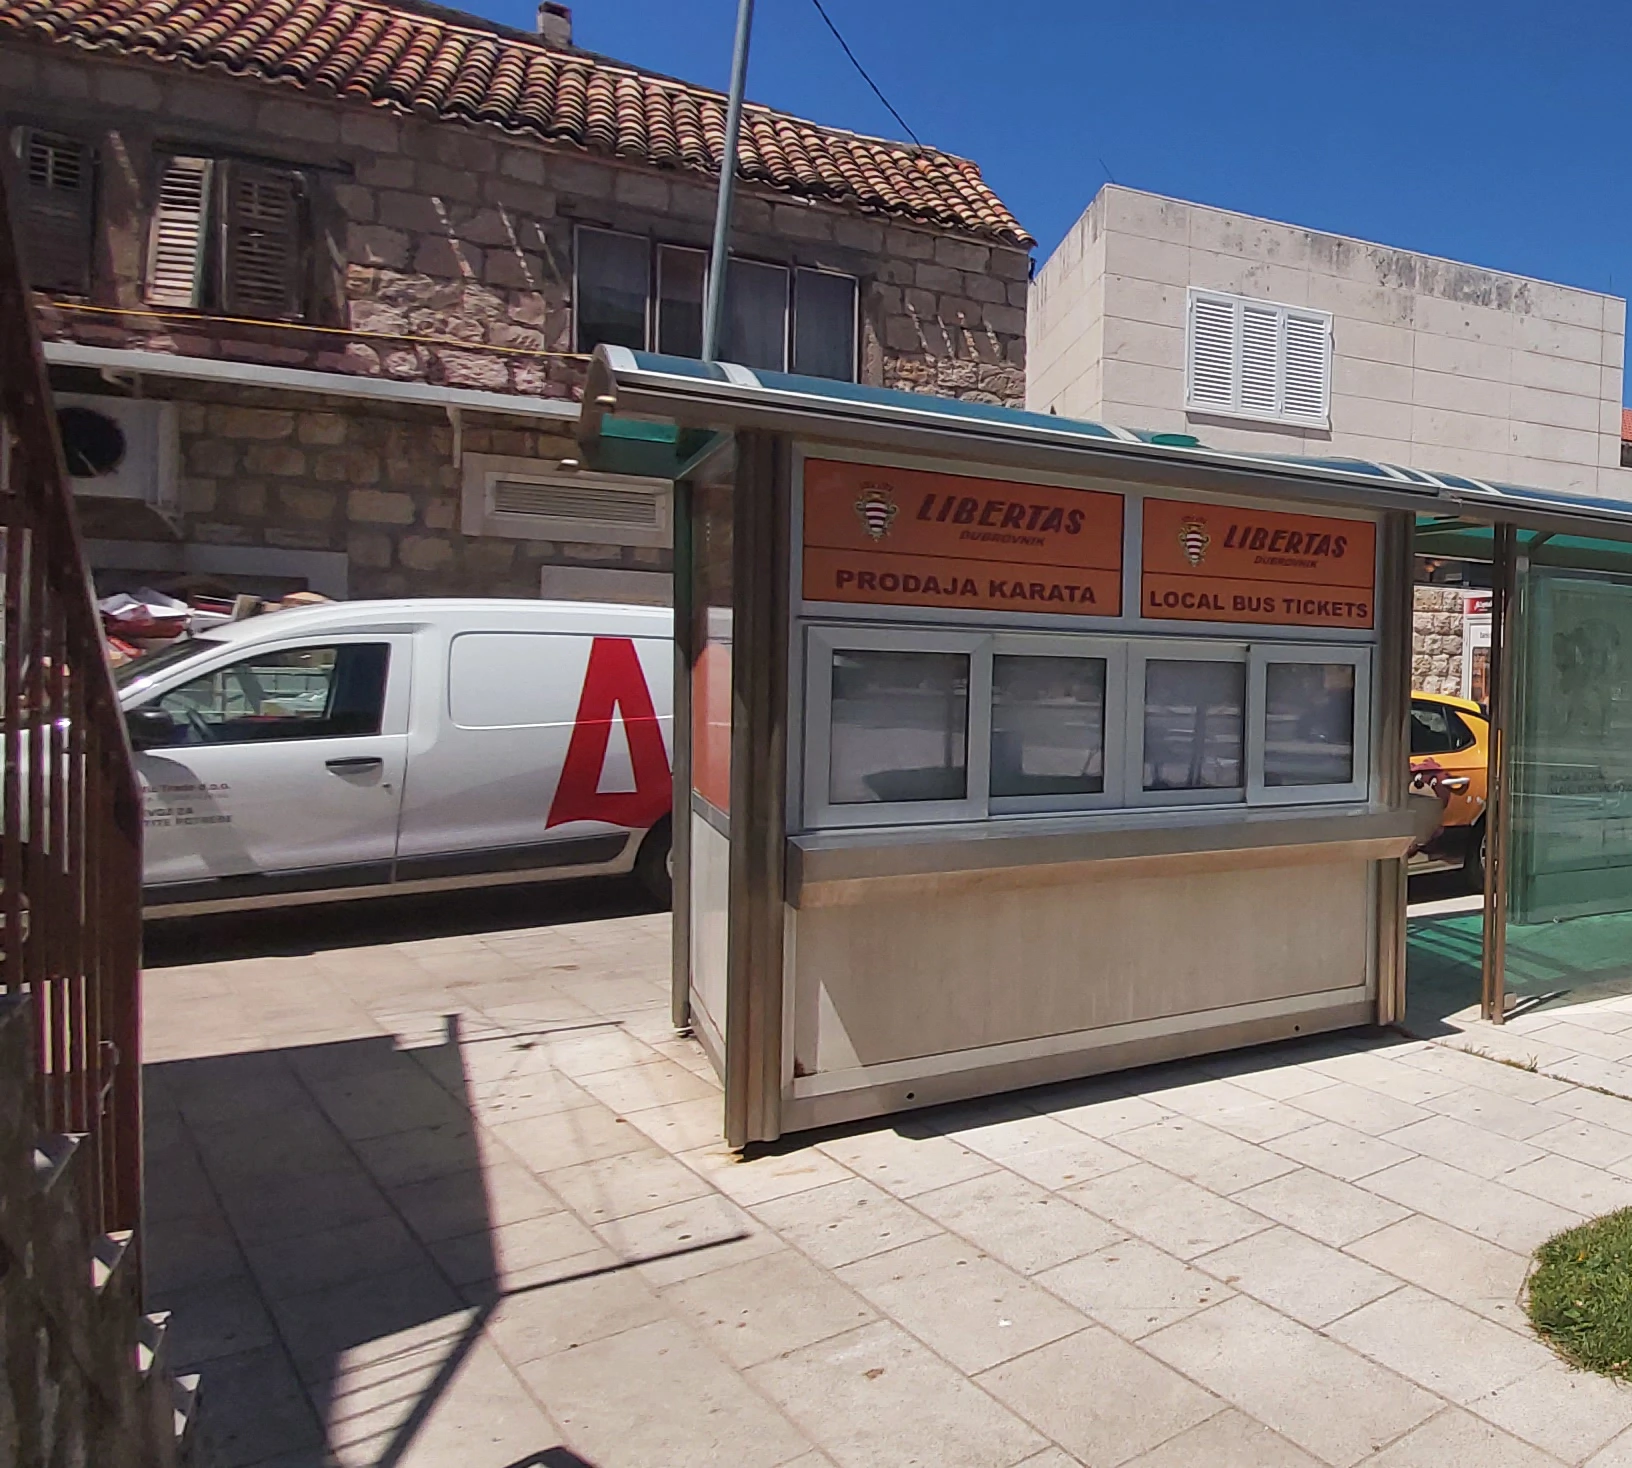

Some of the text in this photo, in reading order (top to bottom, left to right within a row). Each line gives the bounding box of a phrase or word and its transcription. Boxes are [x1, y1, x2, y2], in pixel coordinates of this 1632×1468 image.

[917, 493, 1086, 536] LIBERTAS
[960, 530, 1046, 547] DUBROVNIK
[1224, 525, 1347, 558] LIBERTAS
[1254, 556, 1318, 569] DUBROVNIK
[835, 570, 1097, 604] PRODAJA KARATA
[1150, 591, 1368, 618] LOCAL BUS TICKETS
